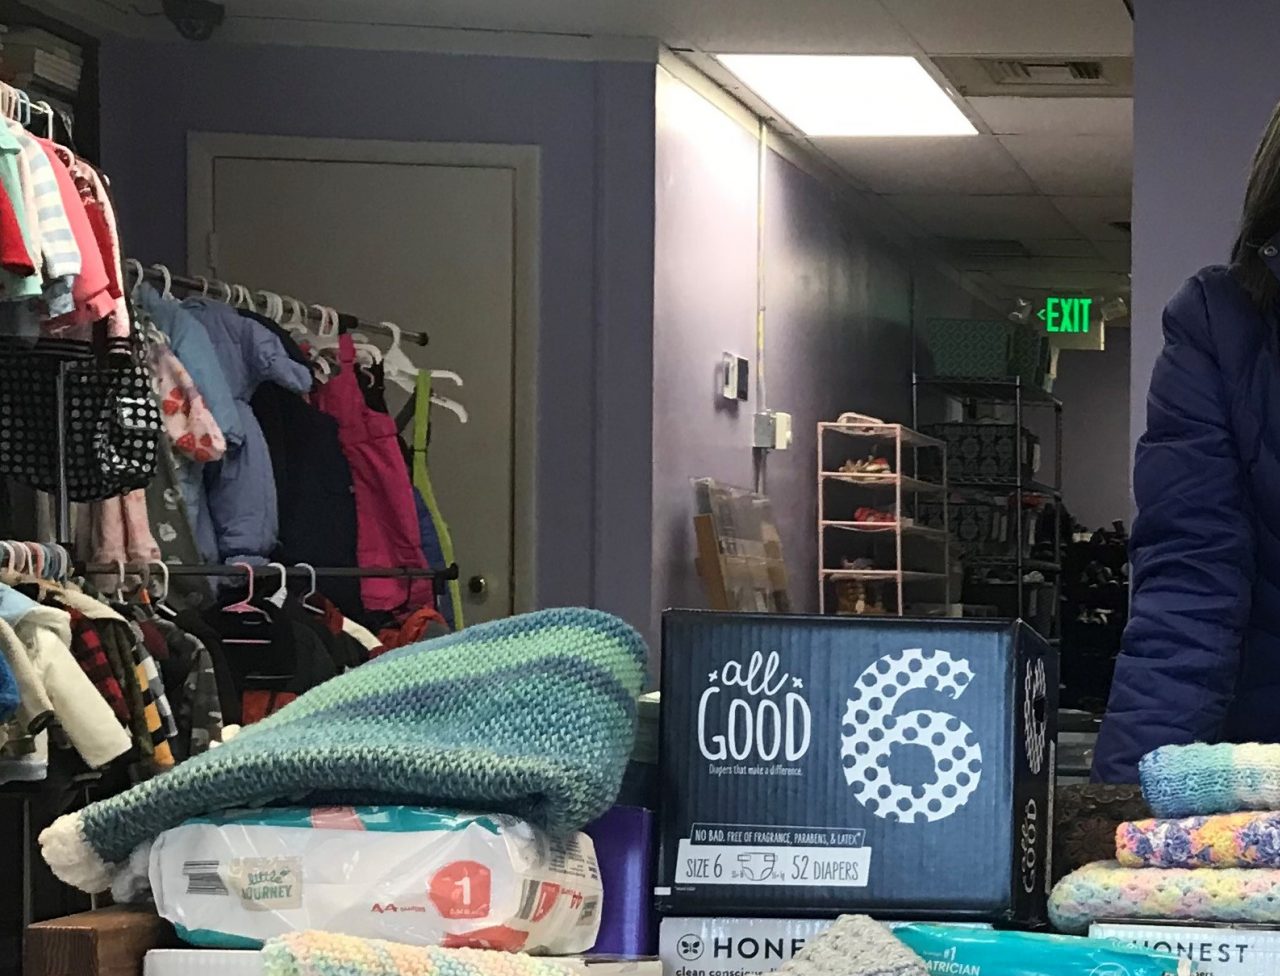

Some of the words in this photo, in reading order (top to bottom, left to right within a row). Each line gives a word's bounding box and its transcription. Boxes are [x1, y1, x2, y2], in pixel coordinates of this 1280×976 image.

[1046, 297, 1092, 333] EXIT
[722, 651, 788, 696] all
[699, 686, 812, 761] GOOD
[840, 648, 982, 823] 6
[709, 763, 732, 777] Diapers
[734, 764, 747, 775] that
[748, 765, 764, 775] make
[695, 830, 706, 842] NO
[708, 830, 725, 842] BAD.
[727, 831, 742, 842] FREE
[744, 831, 752, 843] OF
[754, 831, 793, 845] FRAGRANCE,
[686, 858, 709, 878] SIZE
[714, 853, 722, 878] 6
[791, 855, 808, 880] 52
[814, 861, 859, 881] DIAPERS
[454, 876, 471, 906] 1
[1133, 940, 1249, 963] ONEST
